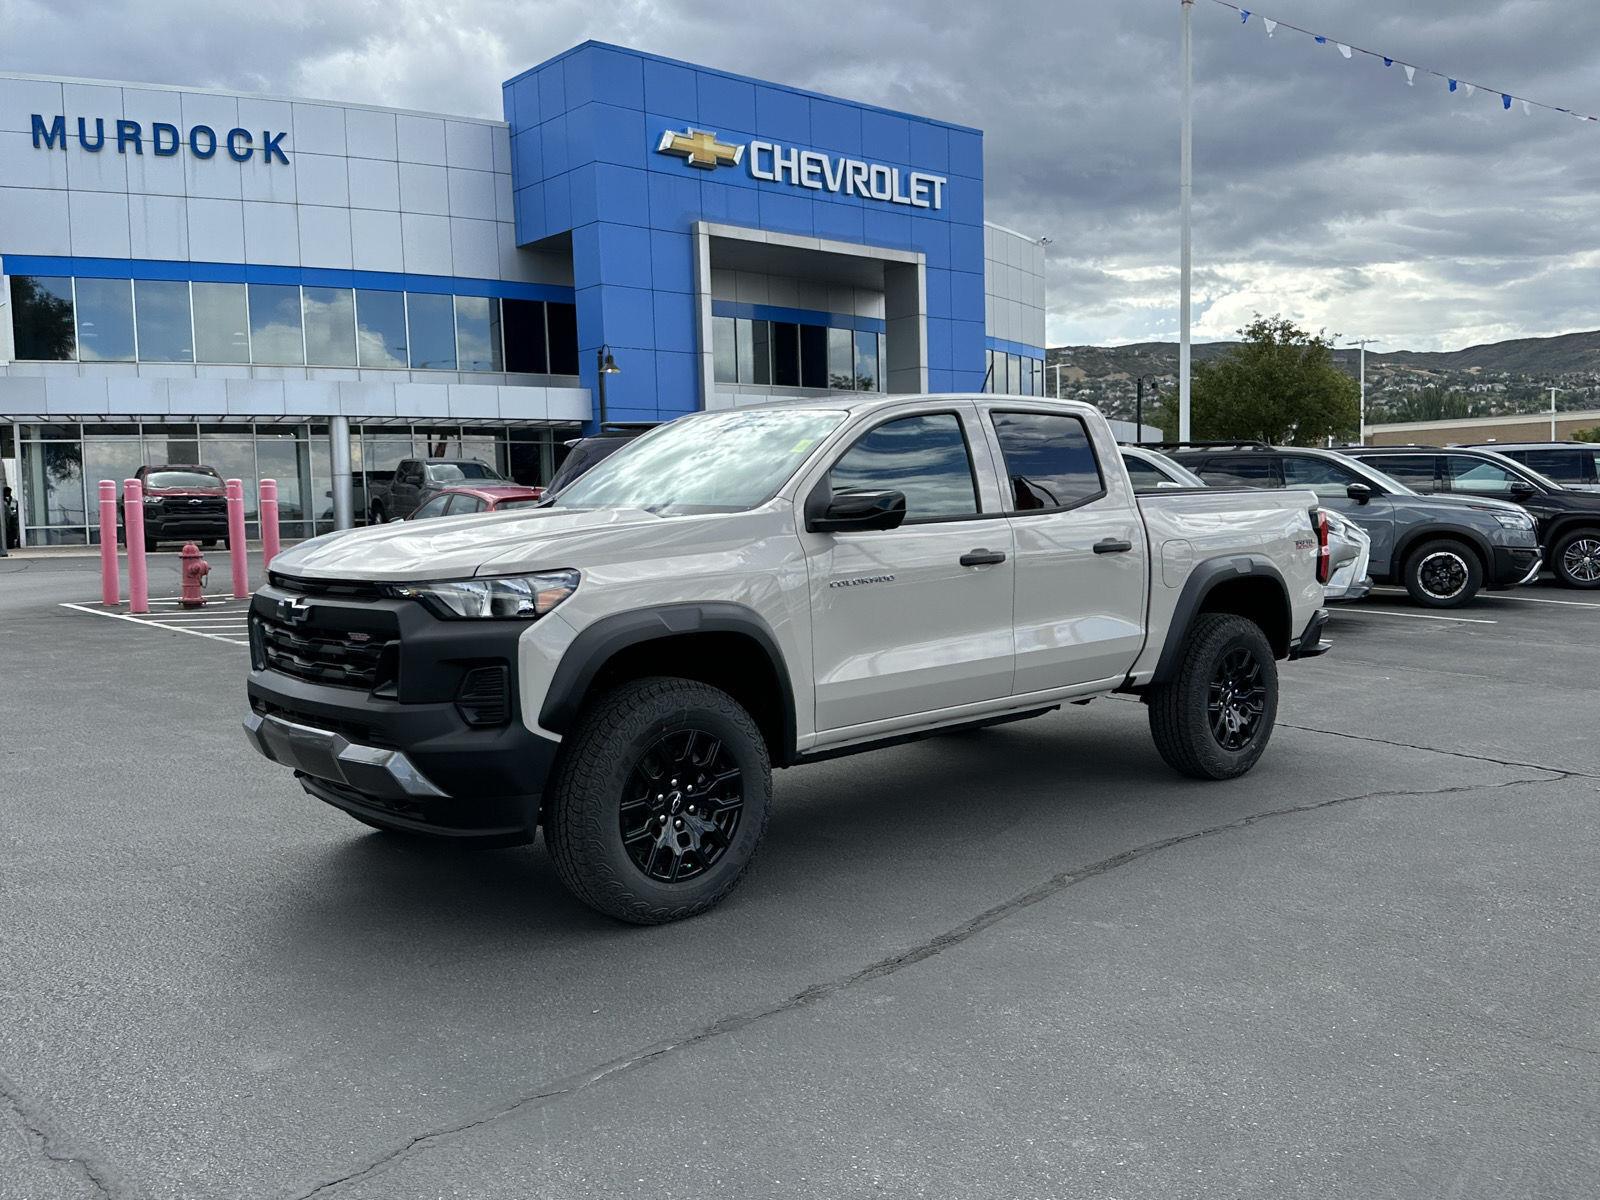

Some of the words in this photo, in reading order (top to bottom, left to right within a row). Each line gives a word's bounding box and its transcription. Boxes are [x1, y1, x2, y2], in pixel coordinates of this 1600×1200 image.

[31, 114, 290, 165] MURDOCK
[750, 140, 947, 210] CHEVROLET
[829, 574, 896, 588] COLORADO
